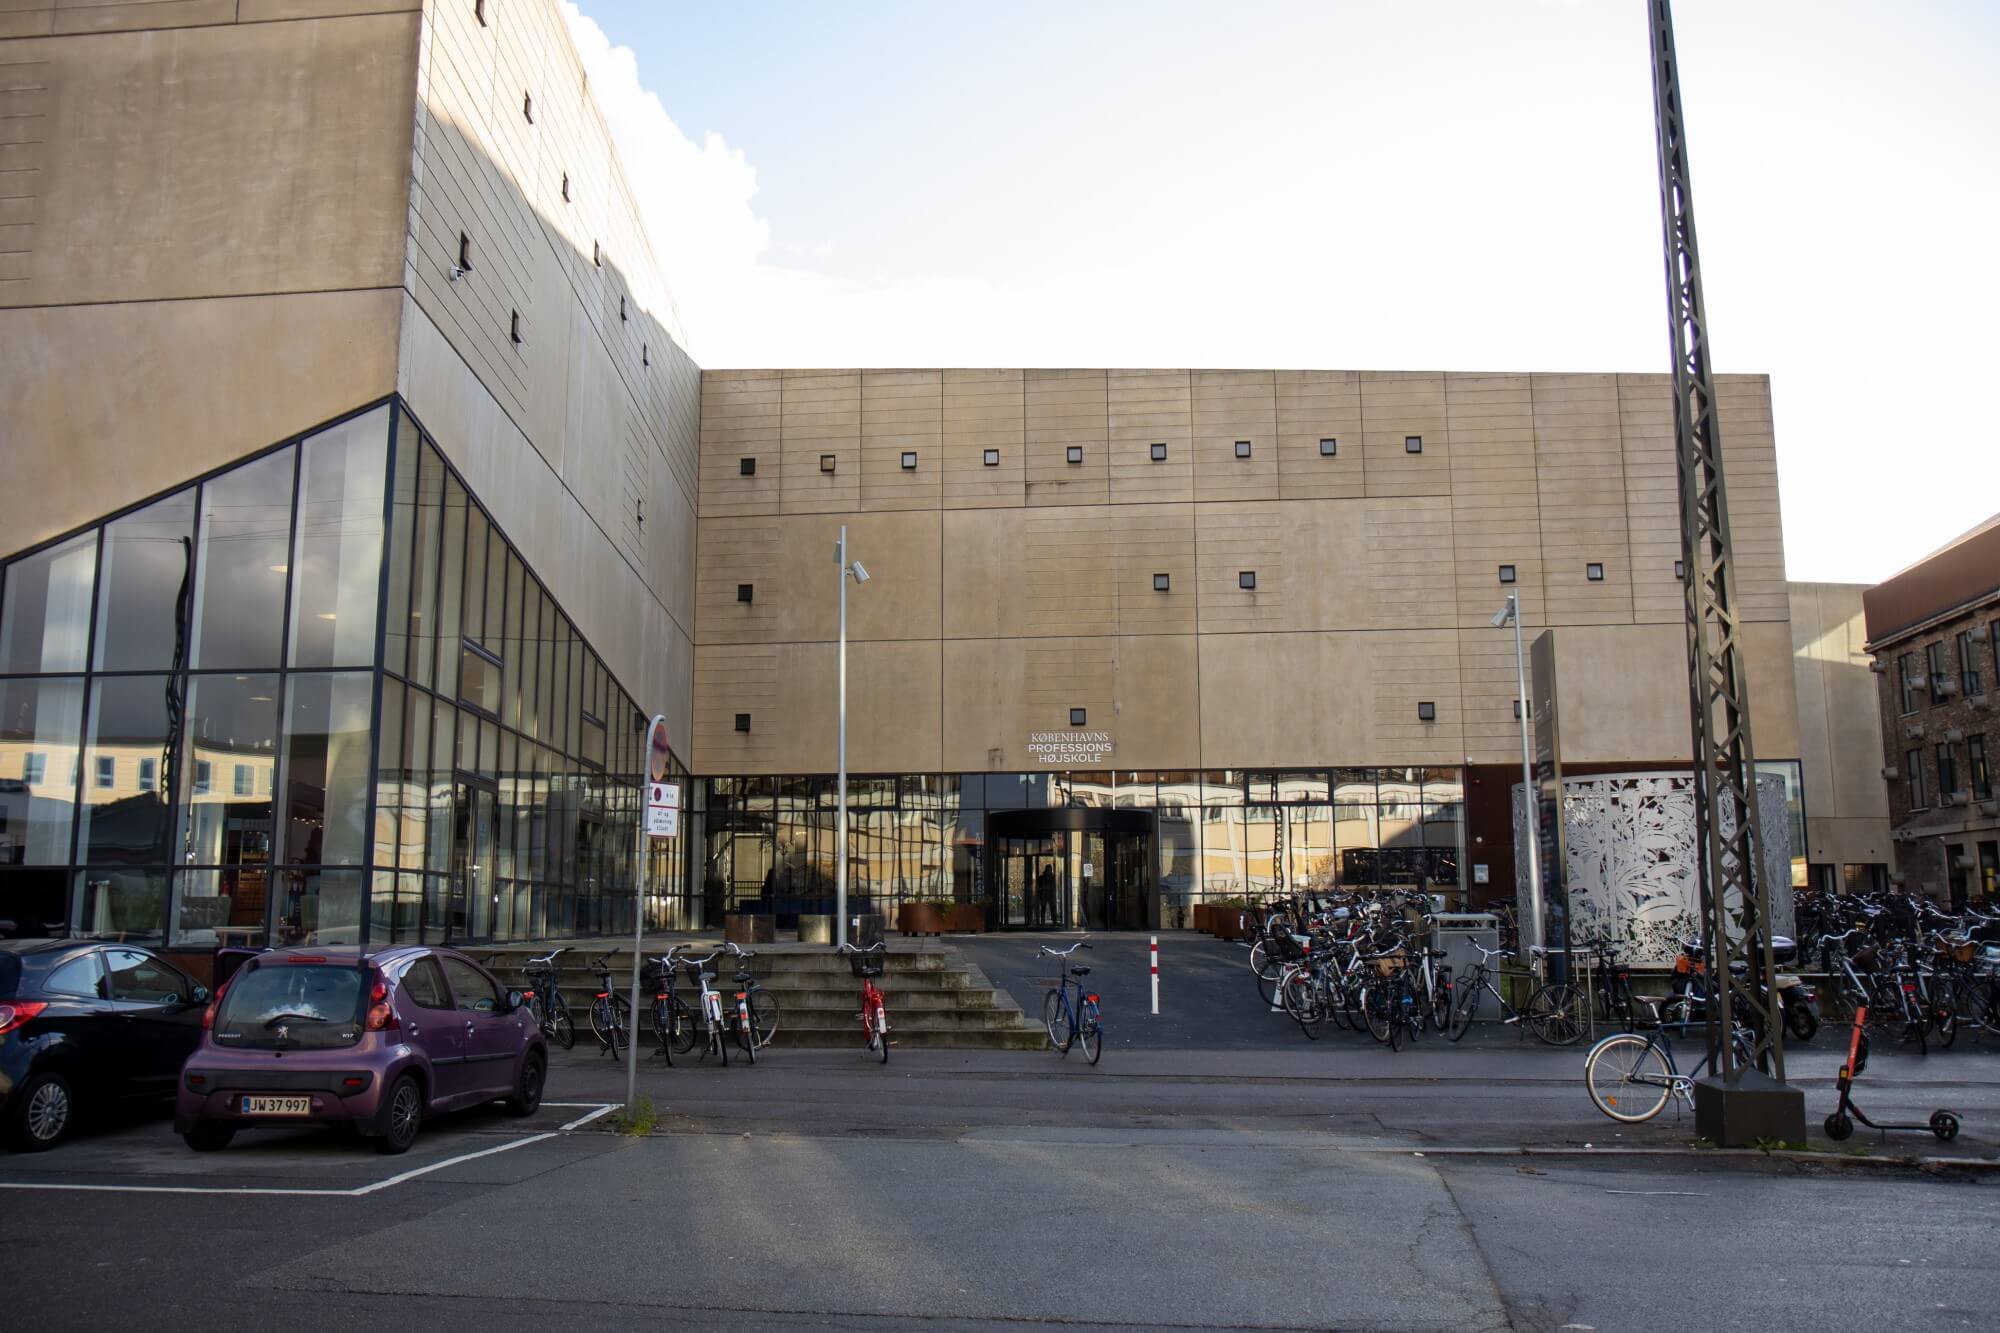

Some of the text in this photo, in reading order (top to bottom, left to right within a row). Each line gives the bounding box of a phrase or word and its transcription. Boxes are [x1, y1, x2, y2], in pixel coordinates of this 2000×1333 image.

[1031, 732, 1109, 742] KØBENHAVNS
[1028, 743, 1112, 753] PROFESSIONS
[1039, 753, 1102, 763] HØJSKOLE
[251, 1099, 307, 1111] JW 37 997
